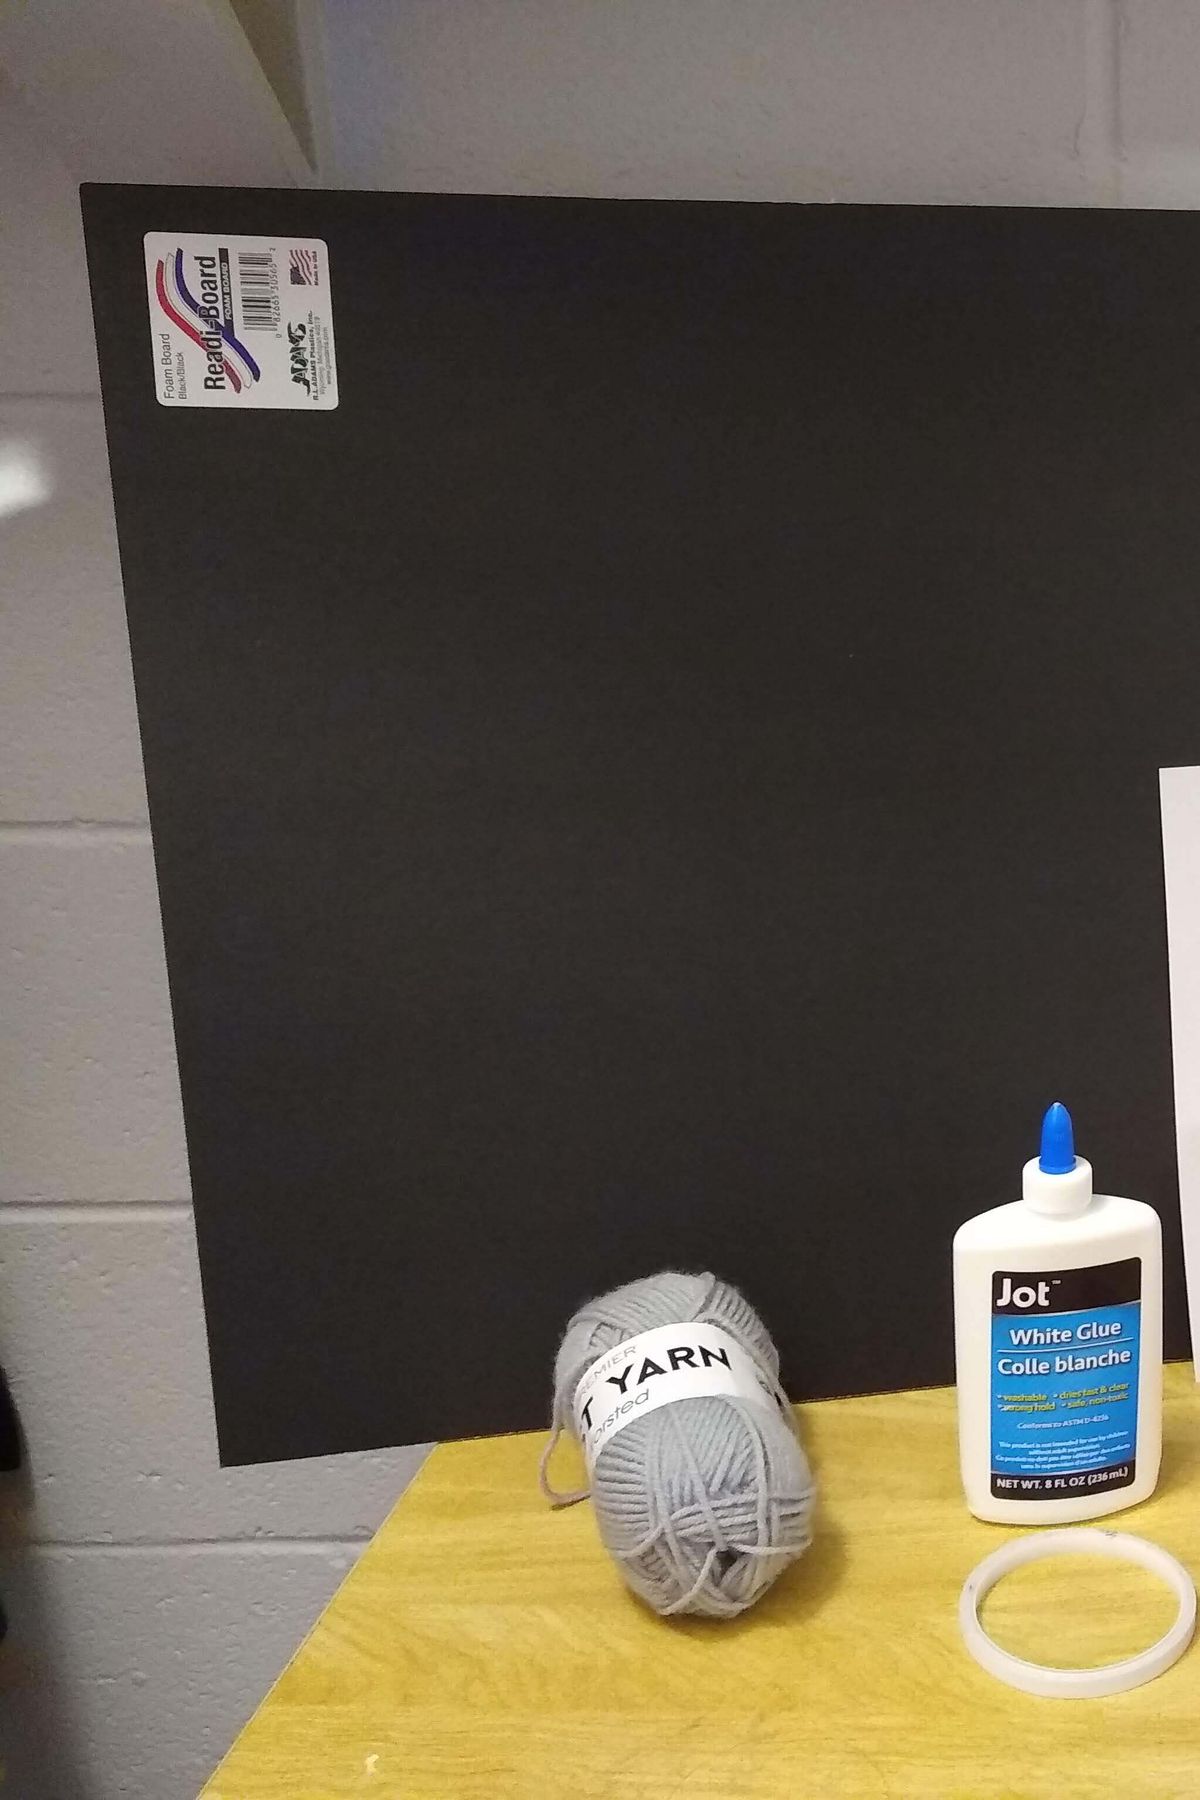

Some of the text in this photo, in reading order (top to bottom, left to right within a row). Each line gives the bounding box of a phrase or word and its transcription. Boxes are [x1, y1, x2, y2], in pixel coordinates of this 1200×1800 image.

[220, 262, 233, 321] FOAM BOARD
[194, 256, 227, 391] Readi-Board
[159, 333, 174, 400] Foam Board
[175, 352, 187, 400] Black/Black
[996, 1278, 1050, 1308] Jot
[1009, 1321, 1122, 1345] White Glue
[606, 1345, 733, 1394] YARN
[997, 1348, 1131, 1375] Colle blanche
[593, 1388, 650, 1445] orsted
[1034, 1401, 1056, 1411] hold
[996, 1466, 1129, 1490] NET WT. 8 FL OZ (236 mL)
